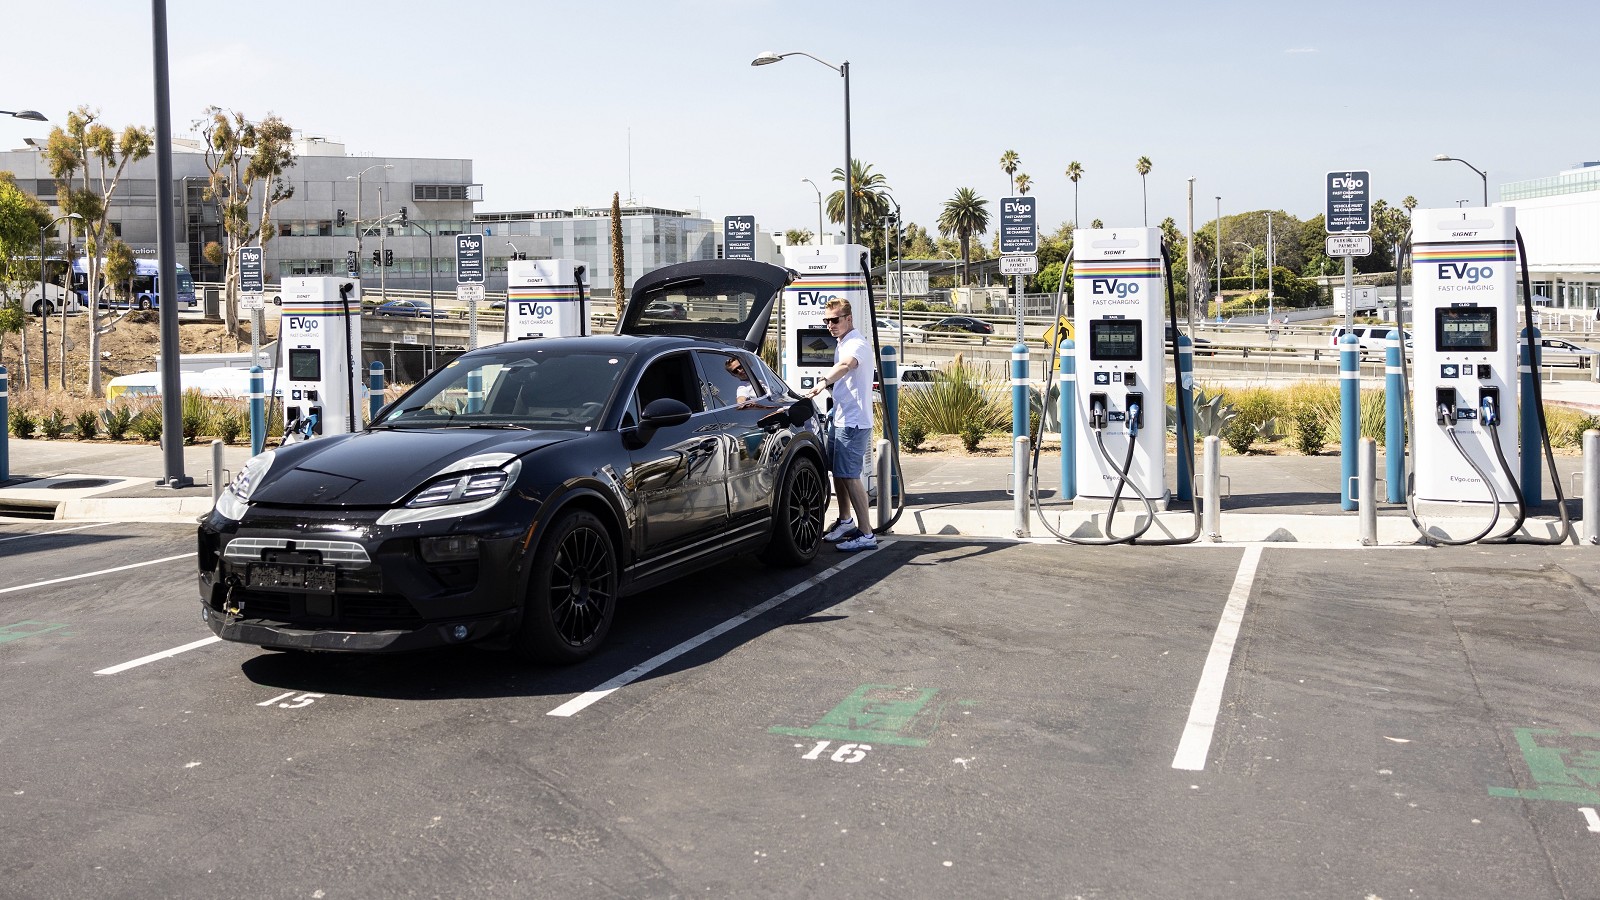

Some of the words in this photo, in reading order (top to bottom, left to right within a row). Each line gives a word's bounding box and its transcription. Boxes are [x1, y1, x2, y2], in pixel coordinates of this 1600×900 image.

[1332, 177, 1363, 190] EVgo
[1005, 203, 1031, 214] EVgo
[729, 221, 751, 231] EVgo
[460, 240, 479, 249] EVgo
[242, 253, 259, 261] EVgo
[1438, 263, 1493, 283] EVgo
[1093, 279, 1139, 298] EVgo
[519, 303, 552, 319] EVgo
[290, 317, 318, 332] EVgo
[256, 692, 325, 708] 15
[802, 741, 872, 763] 16
